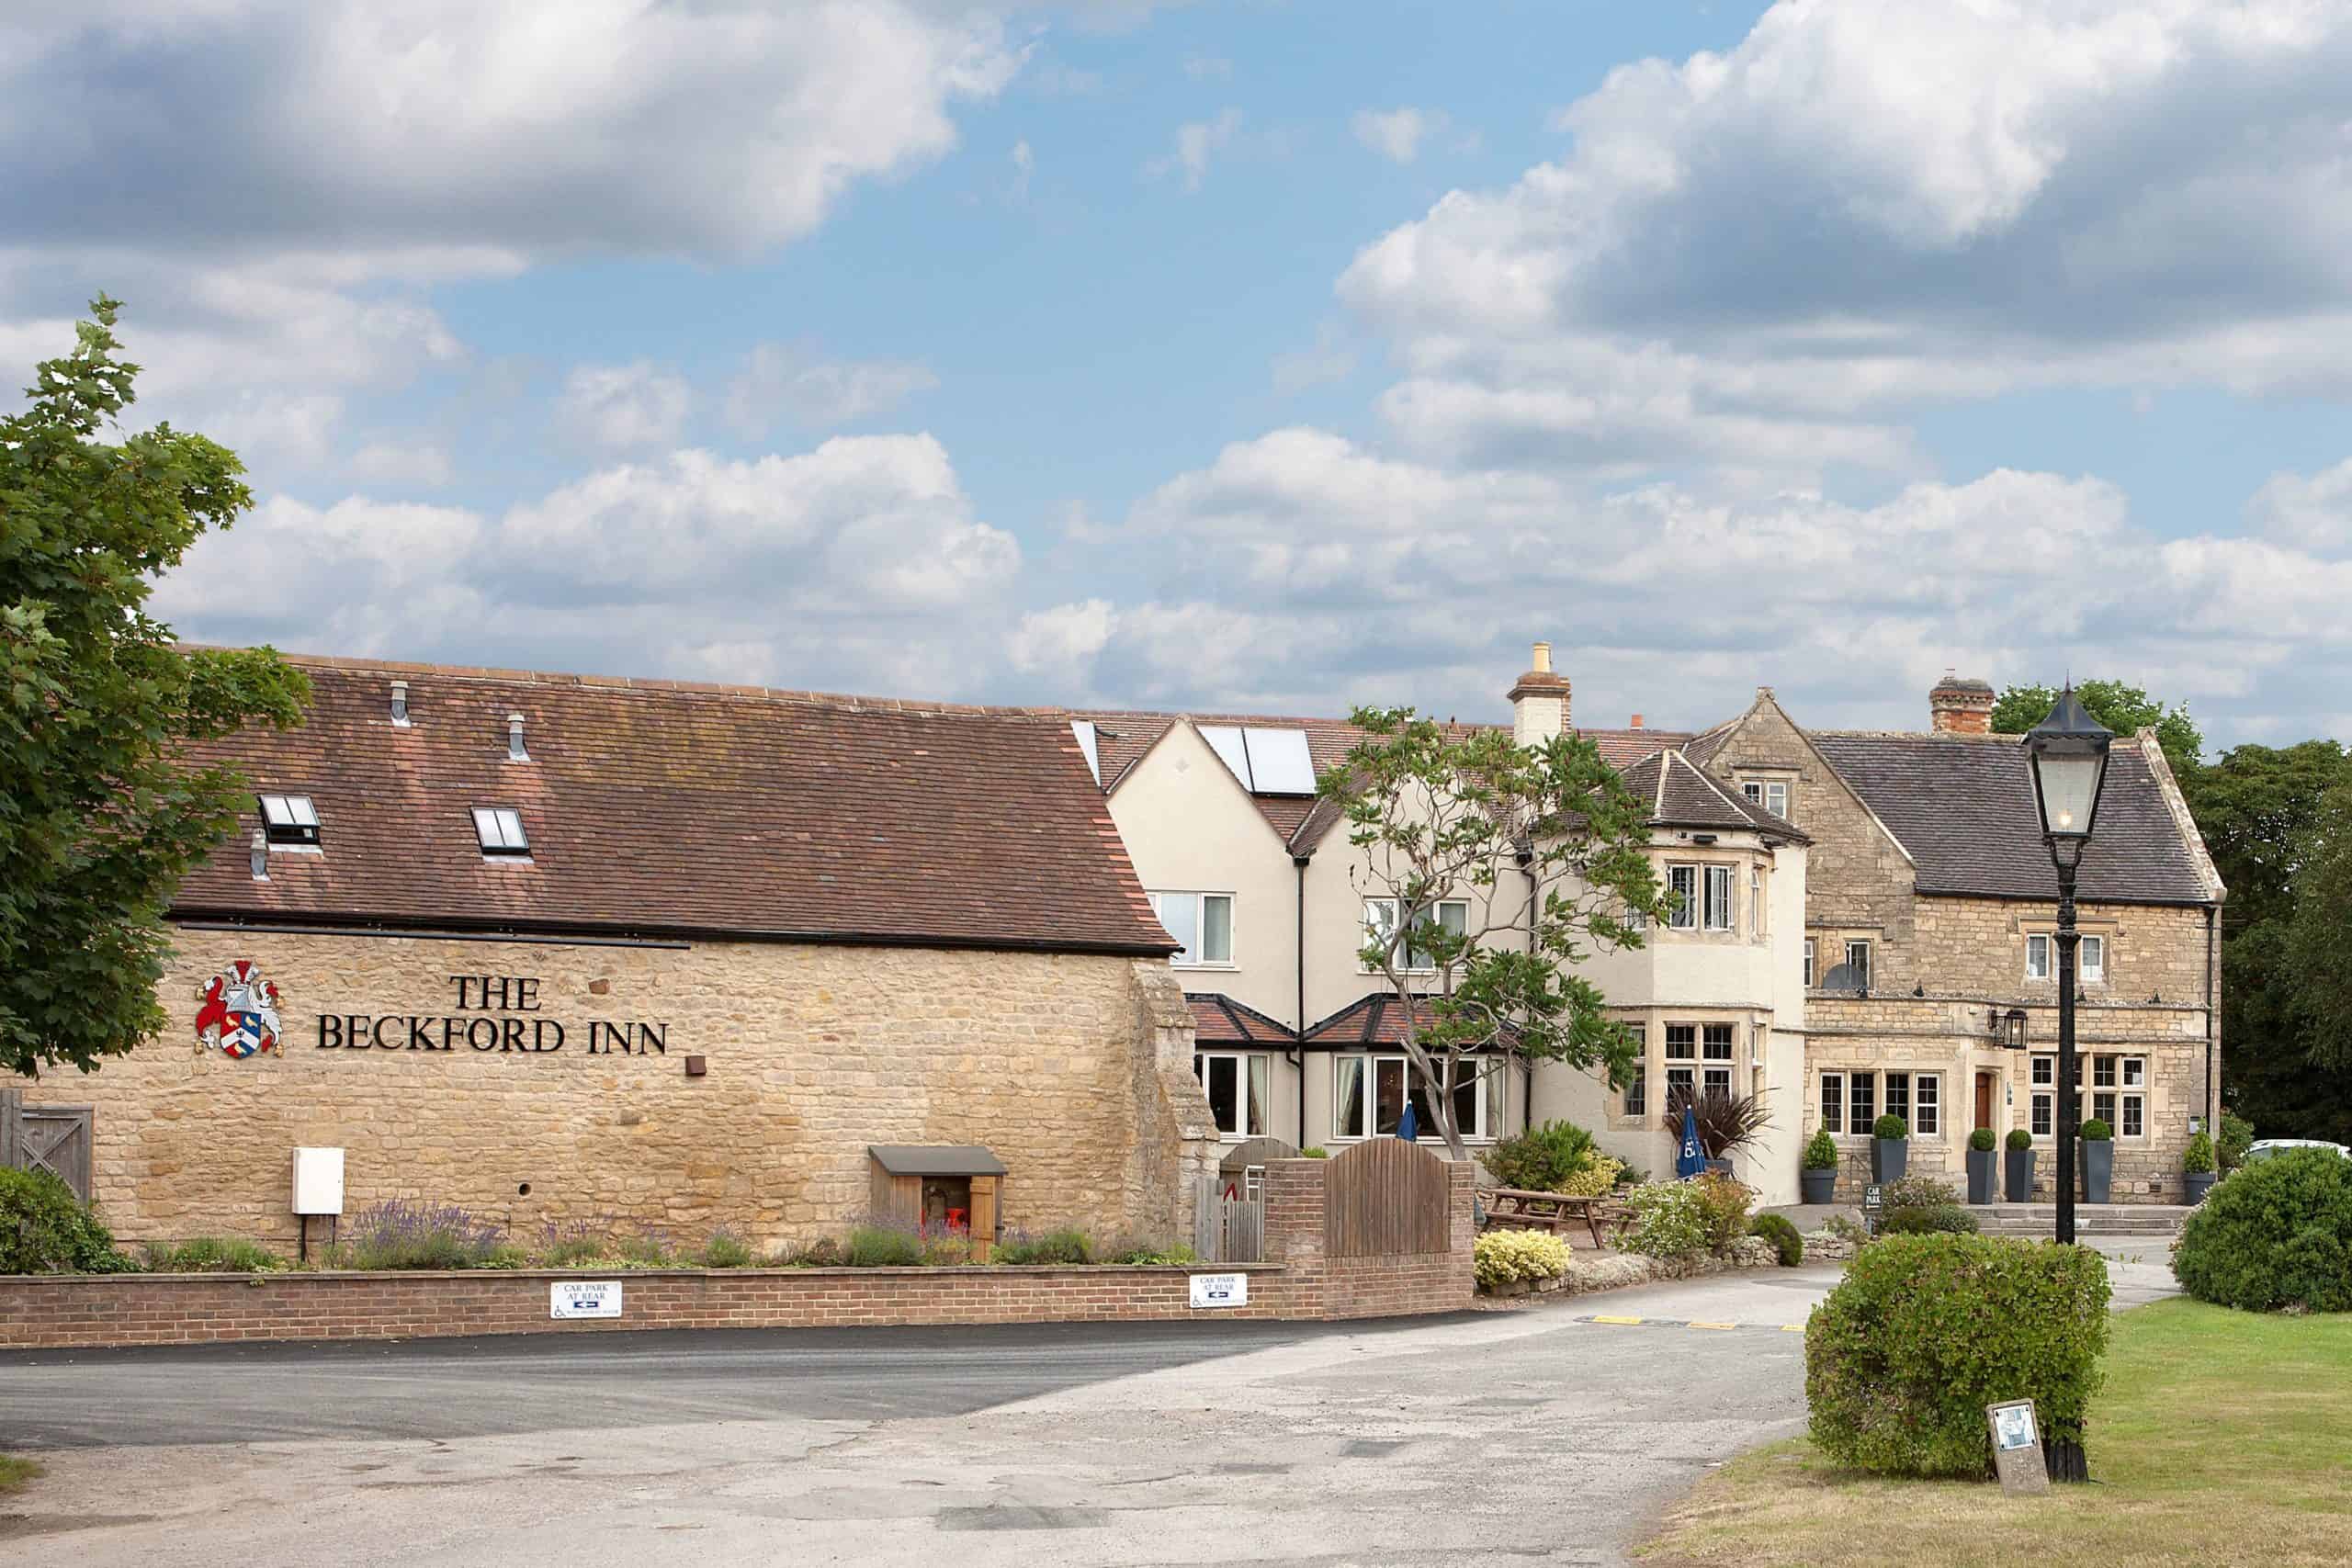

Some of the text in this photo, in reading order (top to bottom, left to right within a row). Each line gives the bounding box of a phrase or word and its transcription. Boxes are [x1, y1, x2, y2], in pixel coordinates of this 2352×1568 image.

[449, 976, 542, 1011] THE
[315, 1014, 670, 1055] BECKFORD INN
[582, 1292, 605, 1301] REAR
